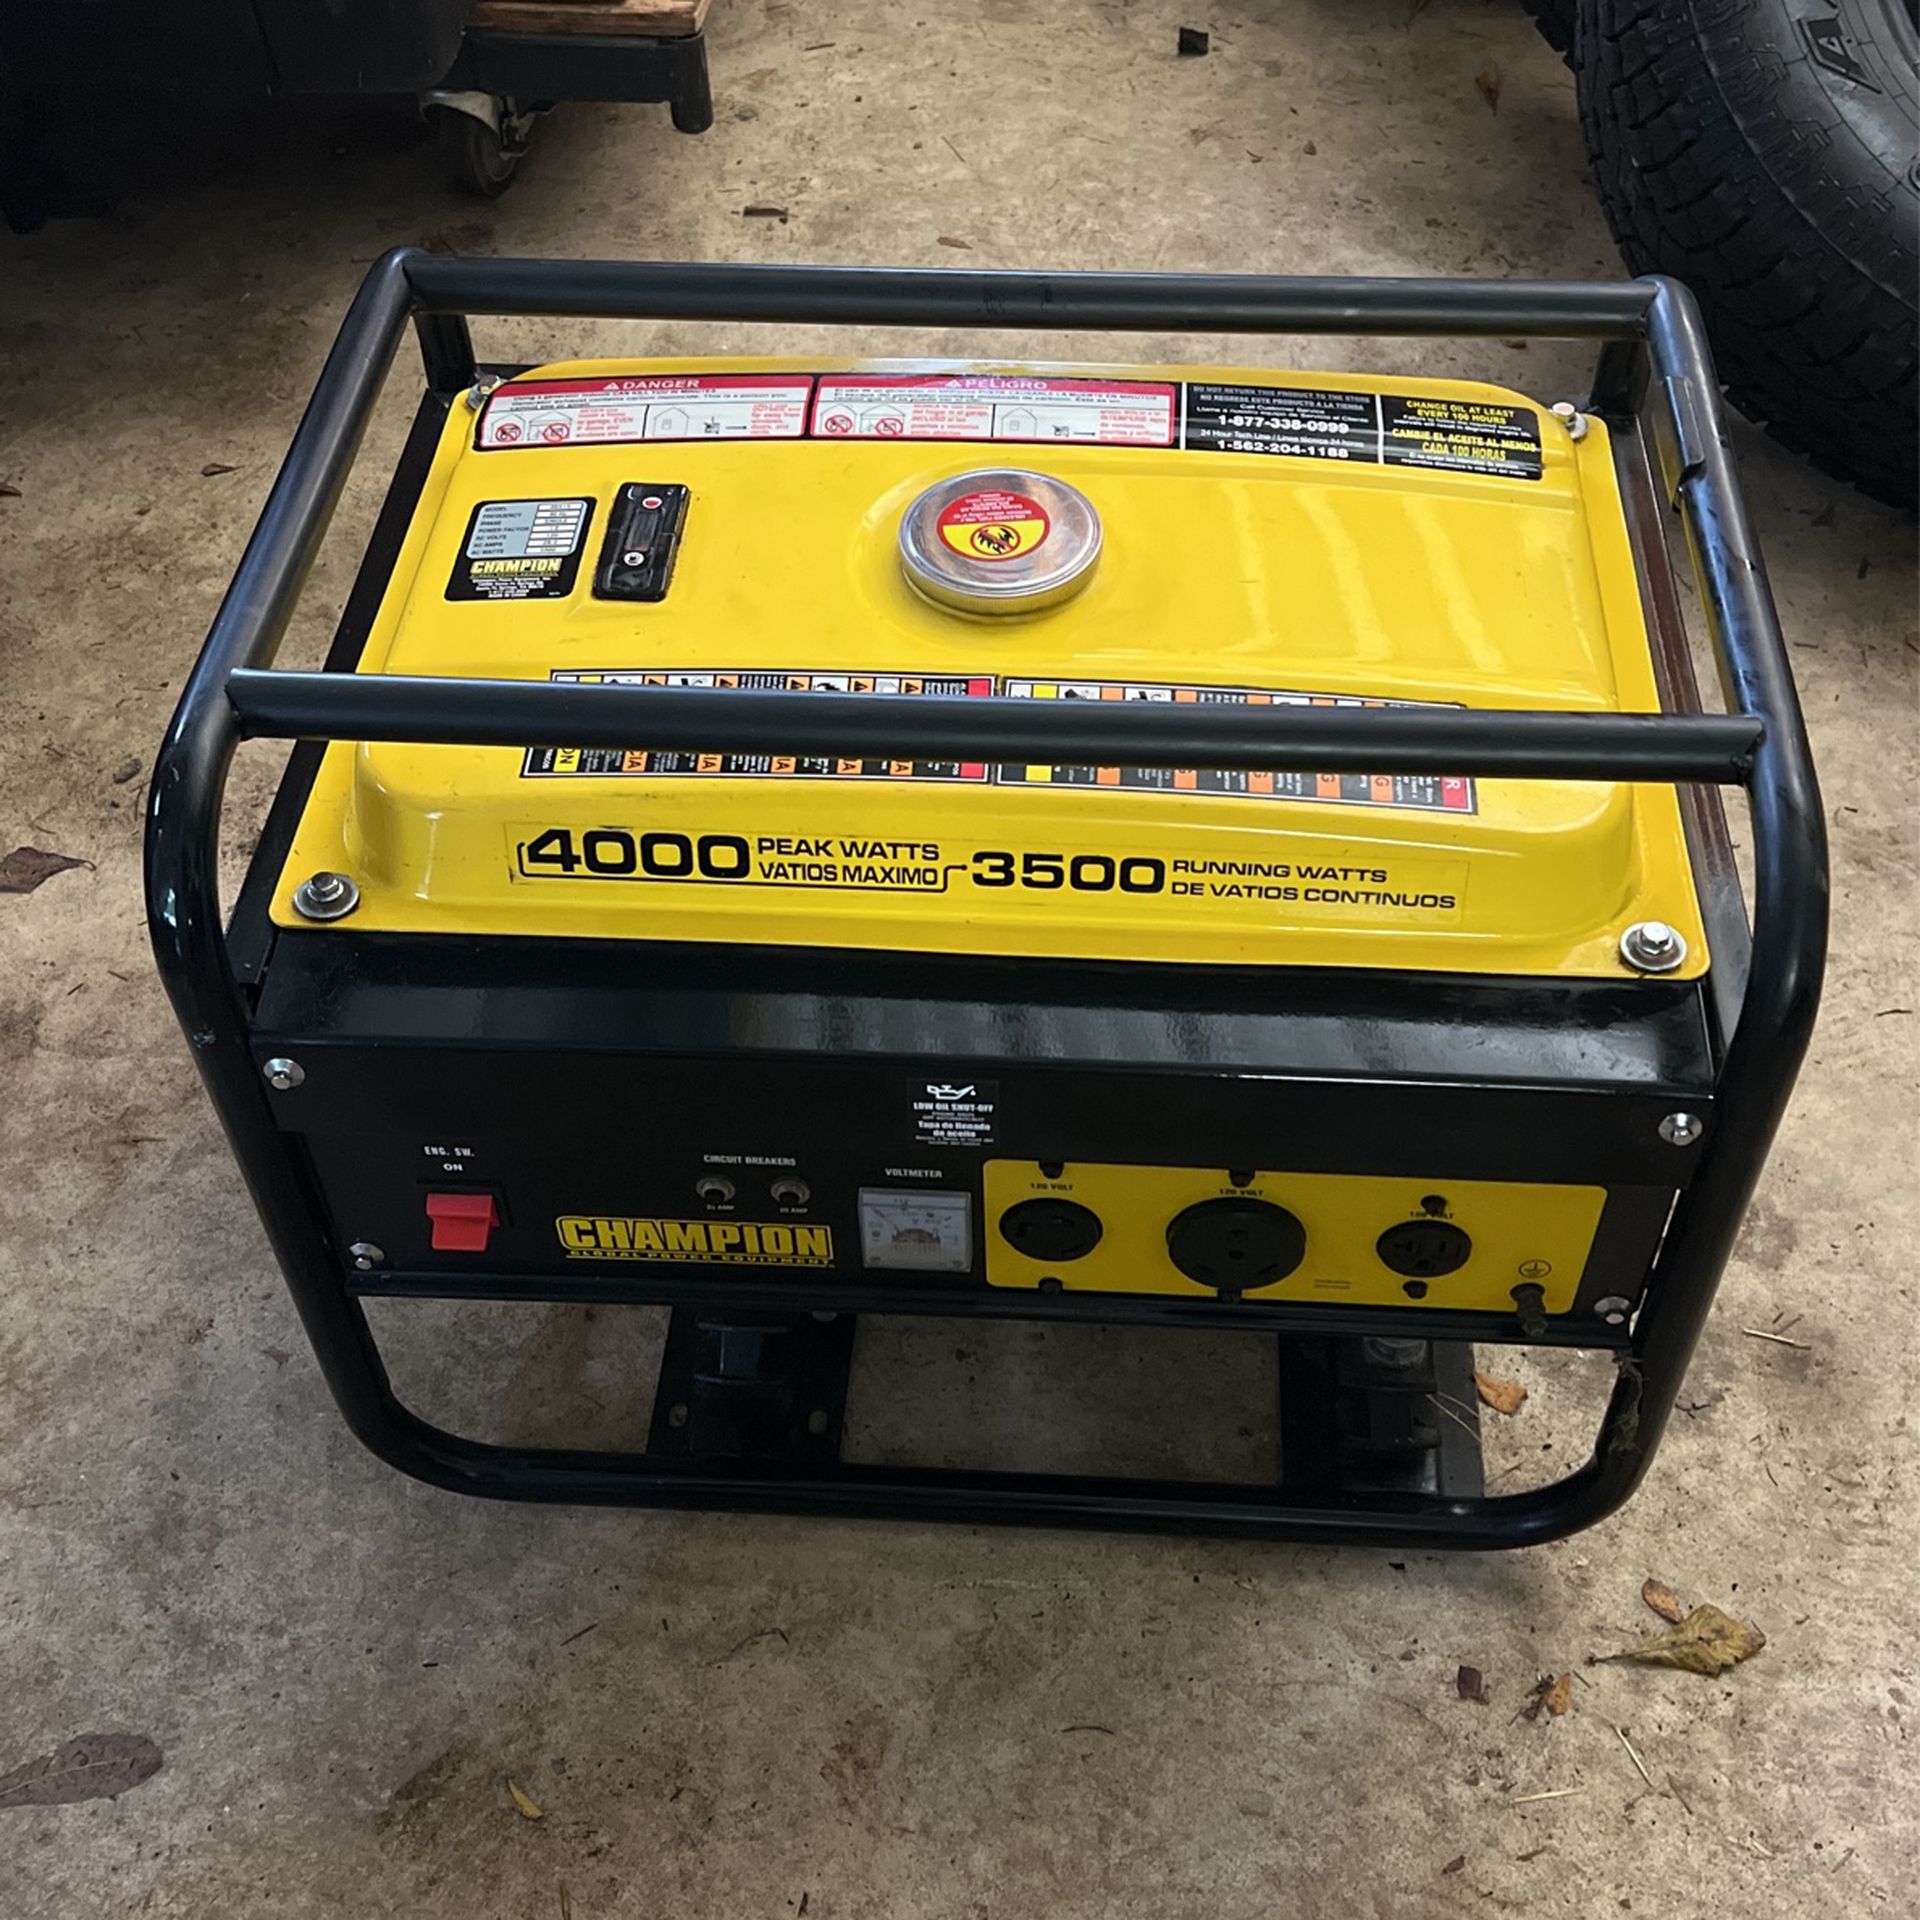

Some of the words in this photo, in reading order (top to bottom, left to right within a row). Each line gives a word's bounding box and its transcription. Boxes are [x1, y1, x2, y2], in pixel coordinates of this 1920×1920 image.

[622, 379, 700, 391] DANGER
[965, 378, 1047, 390] PELIGRO
[1406, 401, 1449, 411] CHANGE
[1450, 404, 1467, 413] OIL
[1469, 406, 1481, 414] AT
[1483, 407, 1515, 418] LEAST
[1417, 409, 1449, 419] EVERY
[1452, 412, 1470, 421] 100
[1471, 415, 1507, 425] HOURS
[1218, 414, 1350, 434] 1-877-338-0999
[1433, 432, 1447, 442] EL
[1448, 434, 1484, 446] ACEITE
[1485, 437, 1500, 447] AL
[1500, 439, 1537, 452] MENOS
[1422, 442, 1449, 455] CADA
[1452, 445, 1470, 458] 100
[1471, 446, 1507, 462] HORAS
[470, 558, 562, 574] CHAMPION
[527, 829, 751, 879] 4000
[758, 838, 834, 858] PEAK
[840, 841, 940, 861] WATTS
[759, 862, 838, 882] VATIOS
[843, 865, 938, 886] MAXIMO
[971, 850, 1167, 894] 3500
[1172, 860, 1291, 878] RUNNING
[1296, 865, 1387, 883] WATTS
[1171, 882, 1205, 896] DE
[1210, 884, 1299, 900] VATIOS
[1304, 888, 1456, 909] CONTINUOS
[913, 1102, 934, 1111] LOW
[935, 1103, 949, 1111] OIL
[951, 1103, 994, 1112] SHUT-OFF
[424, 1146, 450, 1156] ENG.
[454, 1147, 475, 1157] SW.
[443, 1163, 463, 1171] ON
[703, 1154, 742, 1164] CIRCUIT
[745, 1155, 796, 1167] BREAKERS
[885, 1168, 943, 1179] VOLTMETER
[1050, 1183, 1074, 1191] VOLT
[1239, 1189, 1264, 1197] VOLT
[558, 1216, 832, 1258] CHAMPION
[570, 1249, 640, 1258] GLOBAL
[648, 1252, 706, 1261] POWER
[722, 1255, 831, 1265] EQUIPMENT
